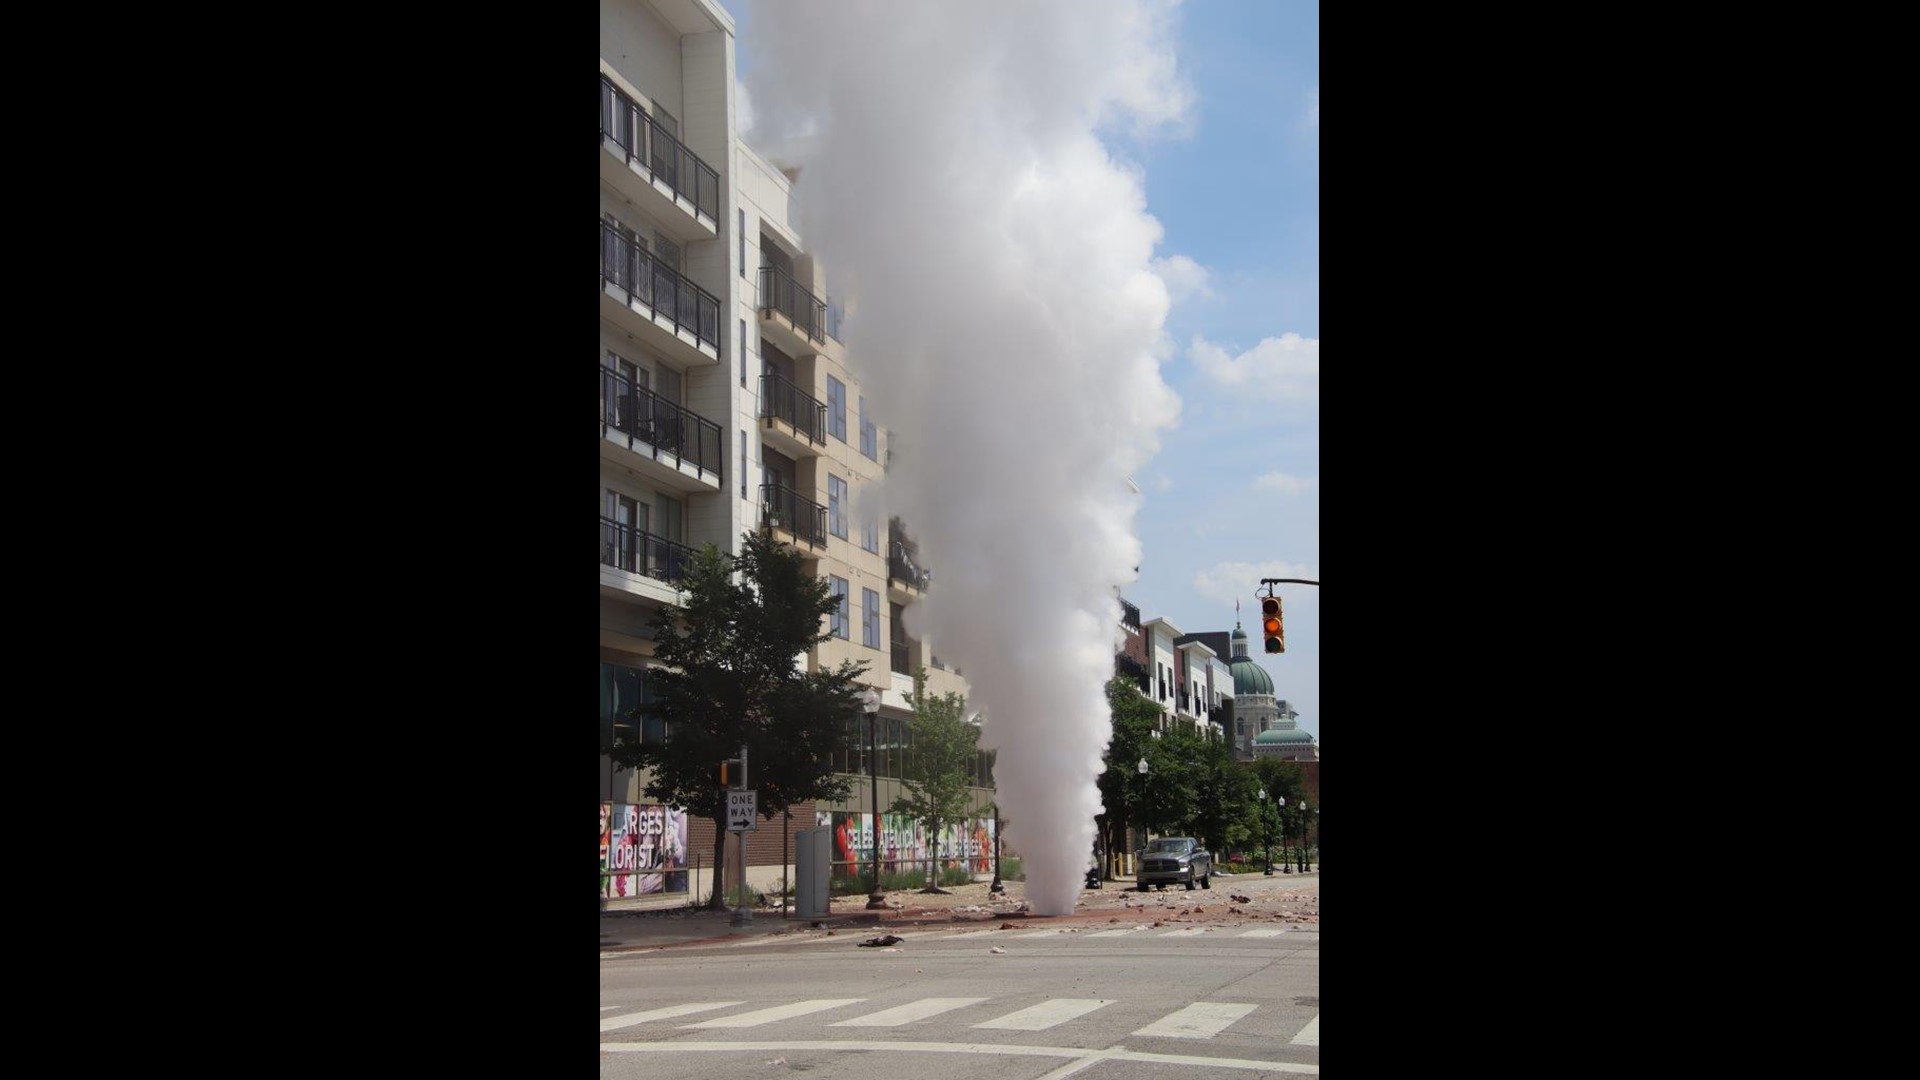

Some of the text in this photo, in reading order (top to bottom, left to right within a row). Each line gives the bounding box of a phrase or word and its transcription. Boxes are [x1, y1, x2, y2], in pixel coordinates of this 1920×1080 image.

[731, 795, 753, 805] ONE
[730, 807, 754, 817] WAY
[847, 829, 896, 849] CELEBATE
[600, 843, 655, 870] FLORIST
